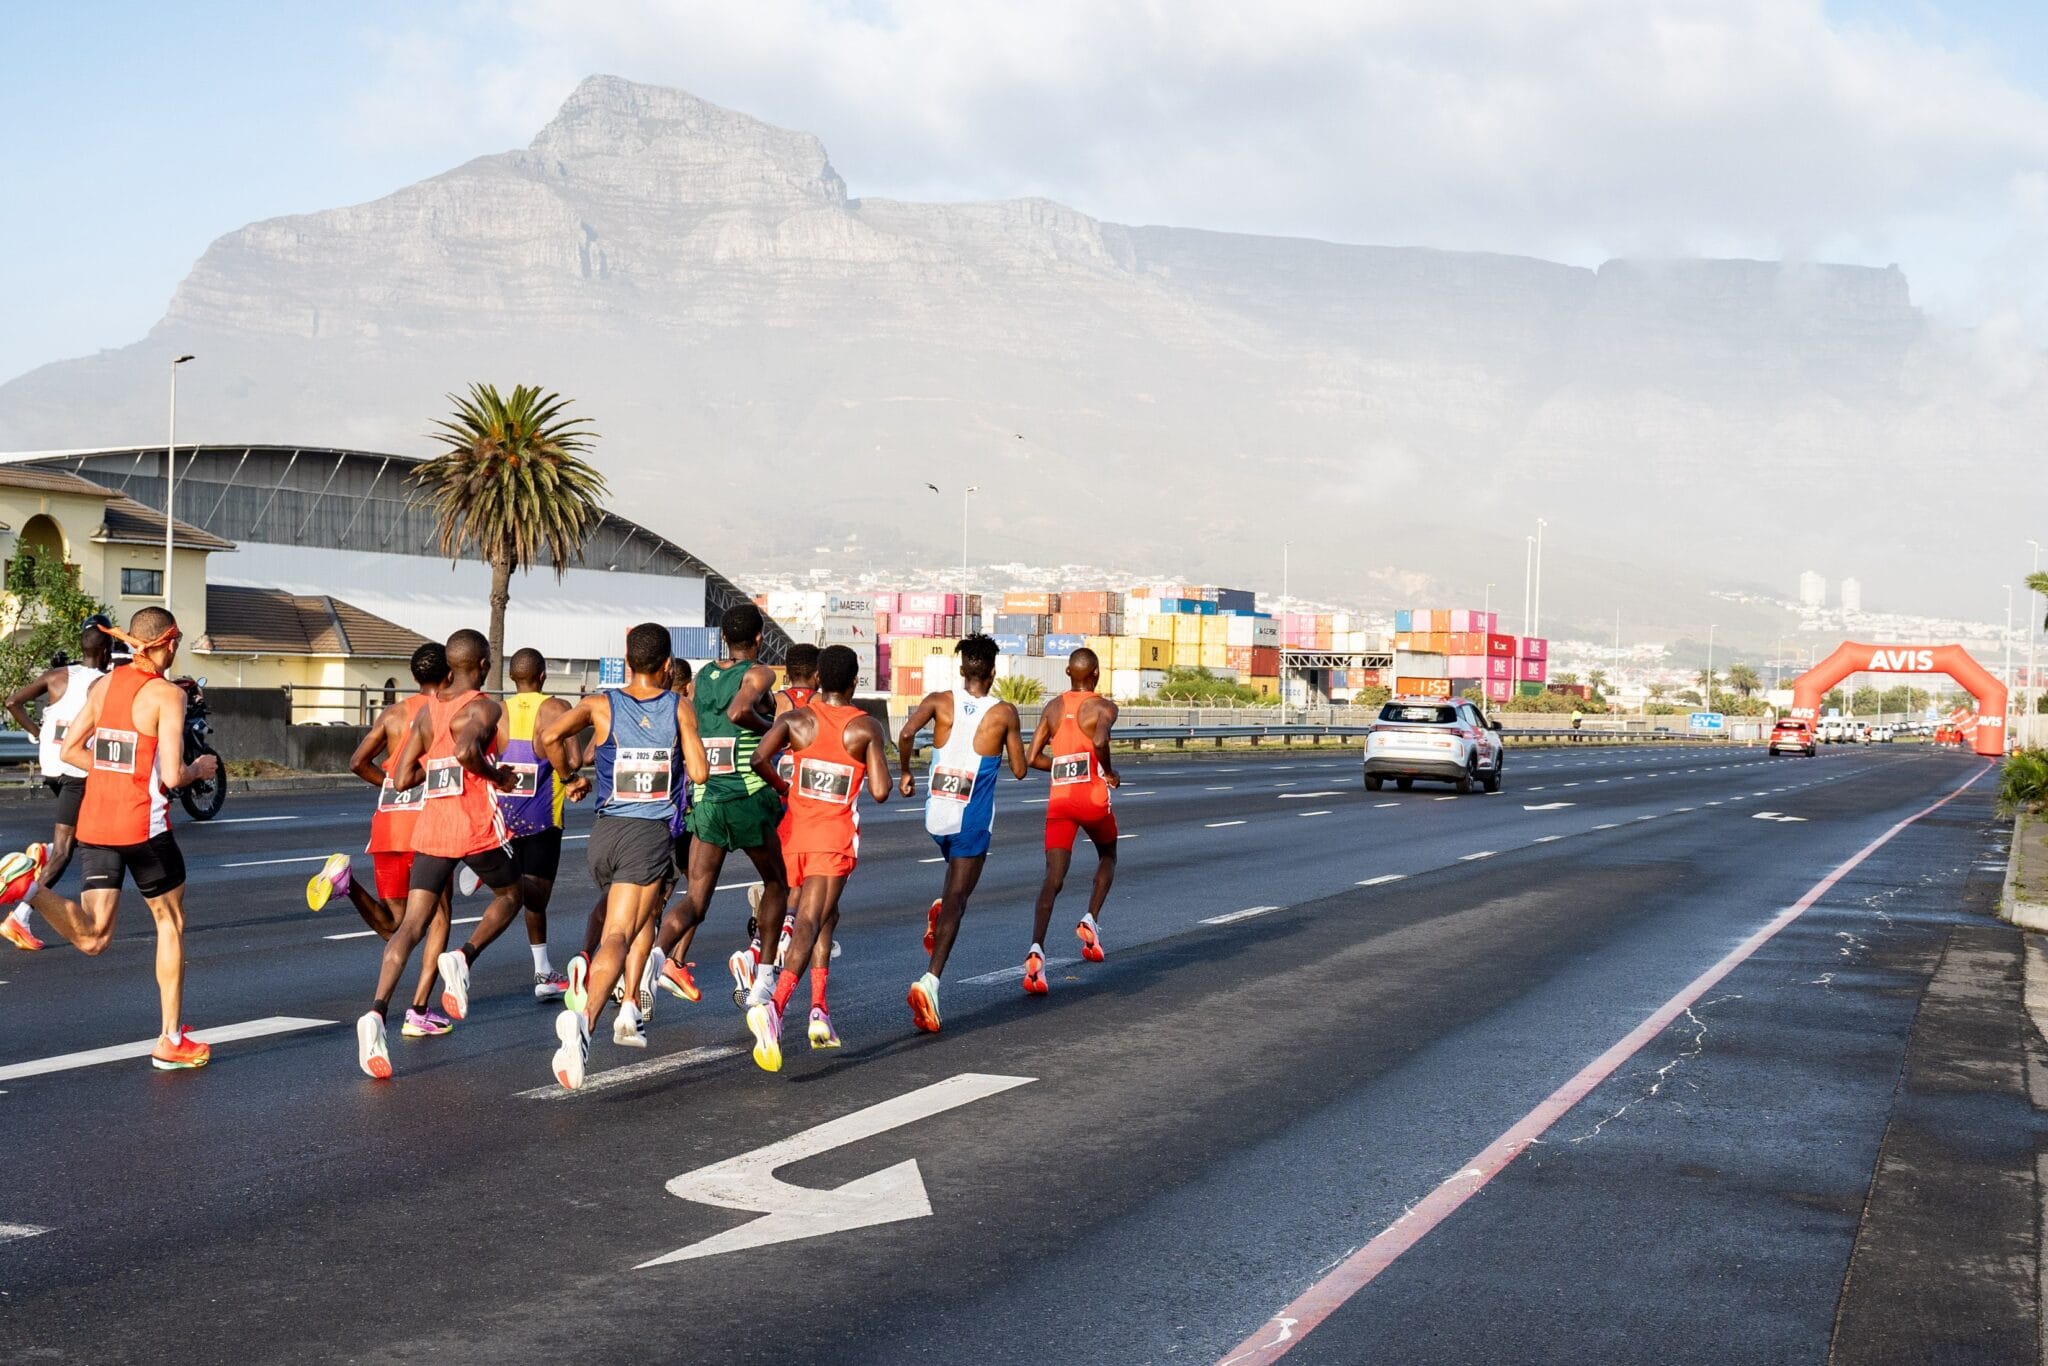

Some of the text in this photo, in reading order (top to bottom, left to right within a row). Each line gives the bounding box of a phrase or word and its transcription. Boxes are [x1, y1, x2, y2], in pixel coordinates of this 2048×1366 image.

[1868, 650, 1934, 670] AVIS
[1791, 707, 1814, 719] AVIS
[1978, 715, 2002, 727] AVIS
[107, 741, 121, 762] 10
[707, 748, 720, 765] 15
[438, 769, 450, 788] 19
[1064, 763, 1078, 777] 13
[633, 772, 653, 793] 18
[814, 772, 834, 792] 22
[942, 775, 960, 793] 23
